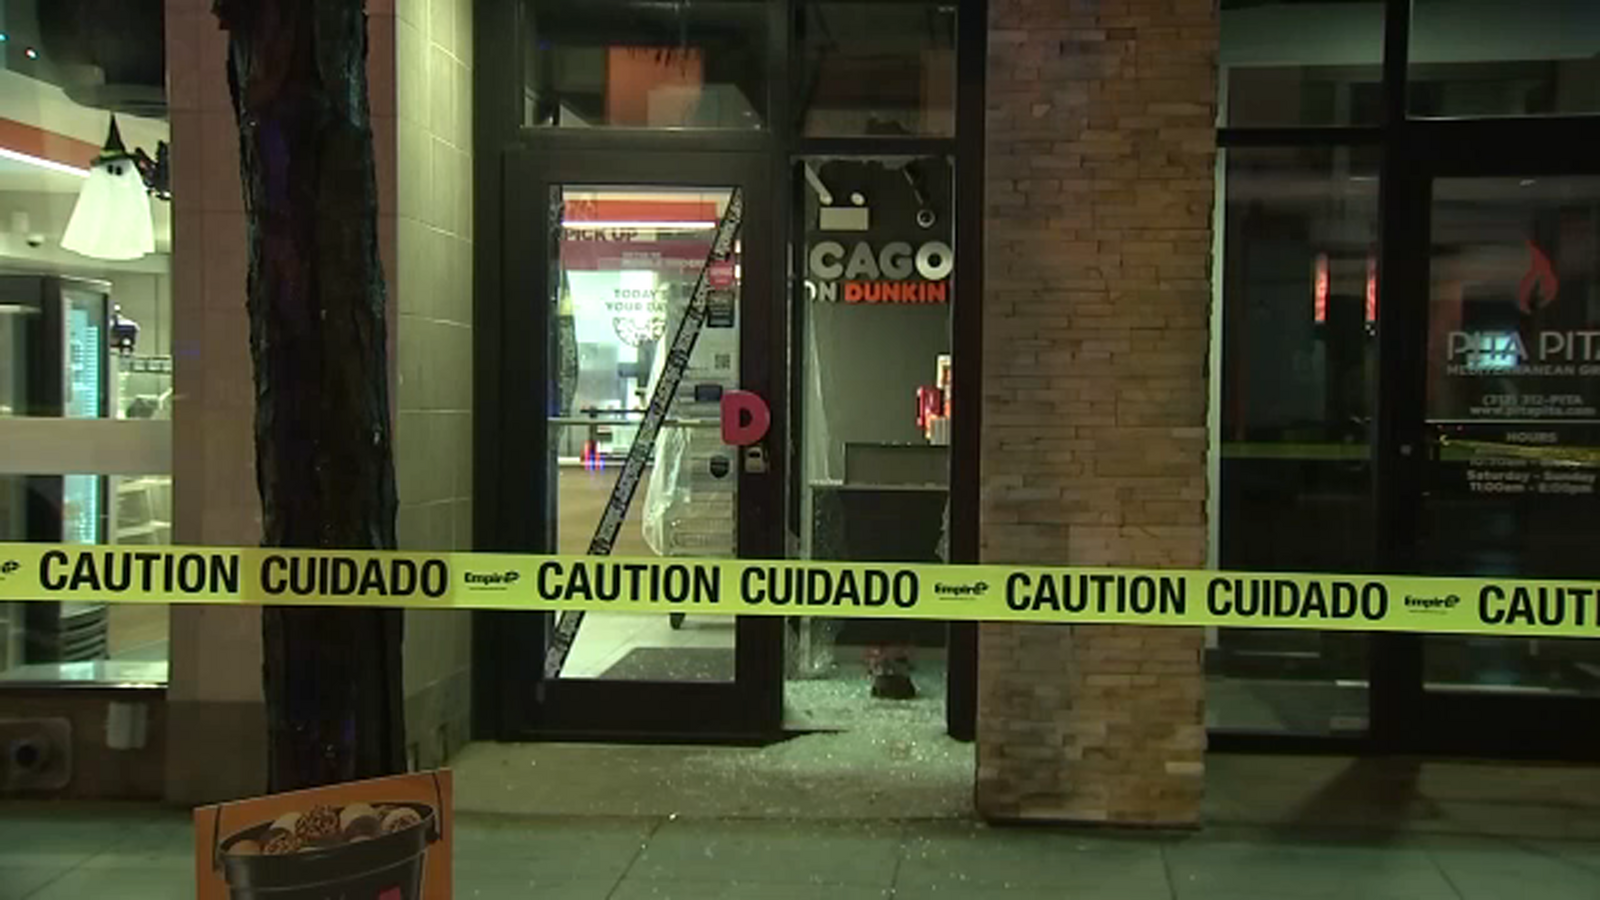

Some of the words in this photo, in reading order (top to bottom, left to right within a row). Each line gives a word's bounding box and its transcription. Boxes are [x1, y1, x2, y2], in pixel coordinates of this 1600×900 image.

[809, 240, 954, 281] CAGO
[1447, 331, 1529, 361] PITA
[1540, 331, 1600, 361] PIT
[1506, 431, 1558, 443] HOURS
[1467, 470, 1530, 484] Saturday
[1543, 471, 1597, 485] Sunday
[39, 548, 240, 594] CAUTION
[260, 554, 448, 598] CUIDADO
[536, 560, 720, 604] CAUTION
[740, 566, 919, 608] CUIDADO
[1005, 571, 1187, 615] CAUTION
[1206, 577, 1388, 621] CUIDADO
